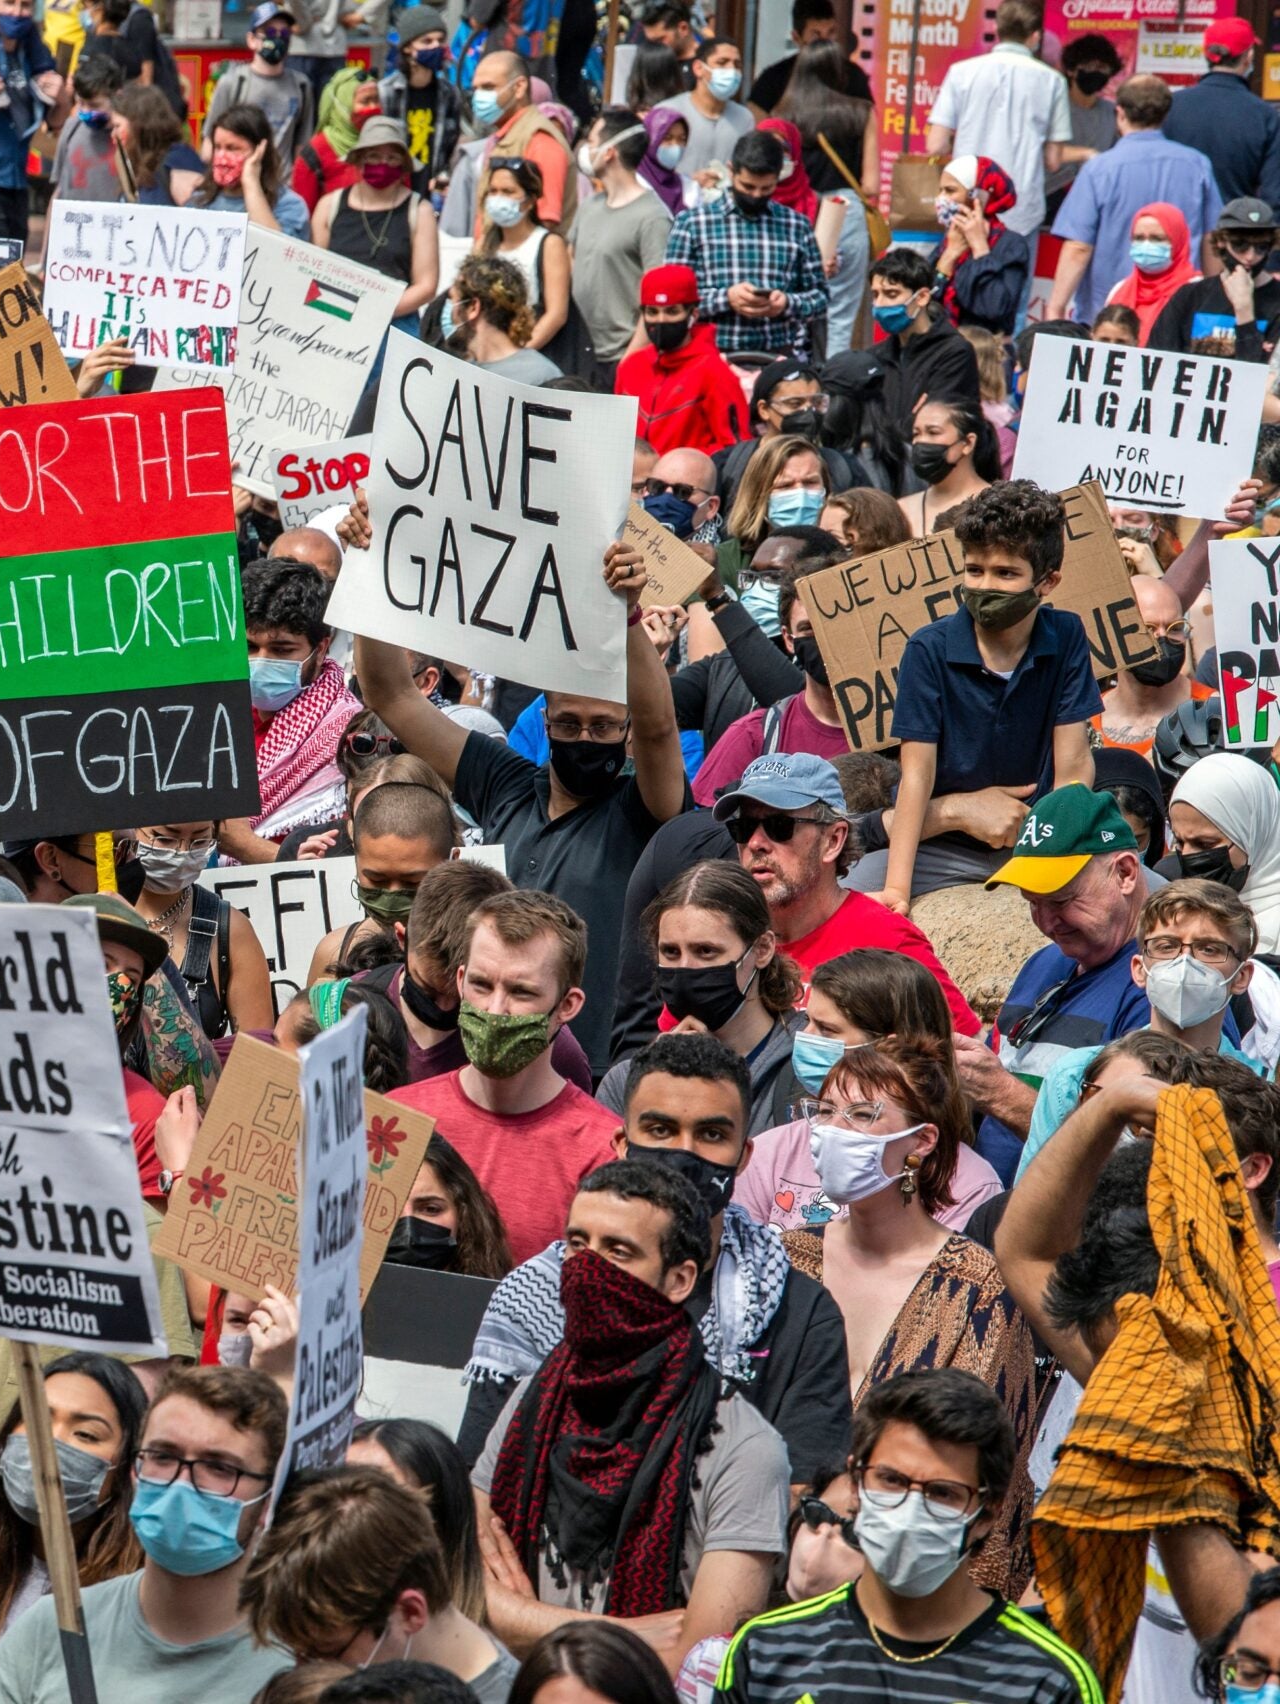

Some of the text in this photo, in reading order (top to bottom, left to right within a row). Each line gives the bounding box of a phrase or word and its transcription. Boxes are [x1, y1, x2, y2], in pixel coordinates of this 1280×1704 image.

[889, 18, 959, 46] Mnth
[891, 0, 970, 22] Hitory
[147, 221, 242, 273] NOT
[49, 261, 231, 309] COMPLICATED
[48, 308, 169, 357] HUMAN
[251, 352, 280, 379] the
[1066, 345, 1232, 402] NEVER
[266, 388, 350, 440] JARRAH
[1057, 387, 1229, 446] AGAIN.
[78, 407, 230, 503] THE
[385, 357, 572, 527] SAVE
[1116, 445, 1150, 465] FOR
[1078, 464, 1186, 500] ANYONE!
[647, 535, 668, 566] the
[384, 504, 579, 651] GAZA
[809, 562, 875, 620] WE
[880, 538, 966, 596] WIL
[74, 702, 239, 796] GAZA
[763, 761, 791, 779] YORK
[5, 1268, 123, 1306] Socialism
